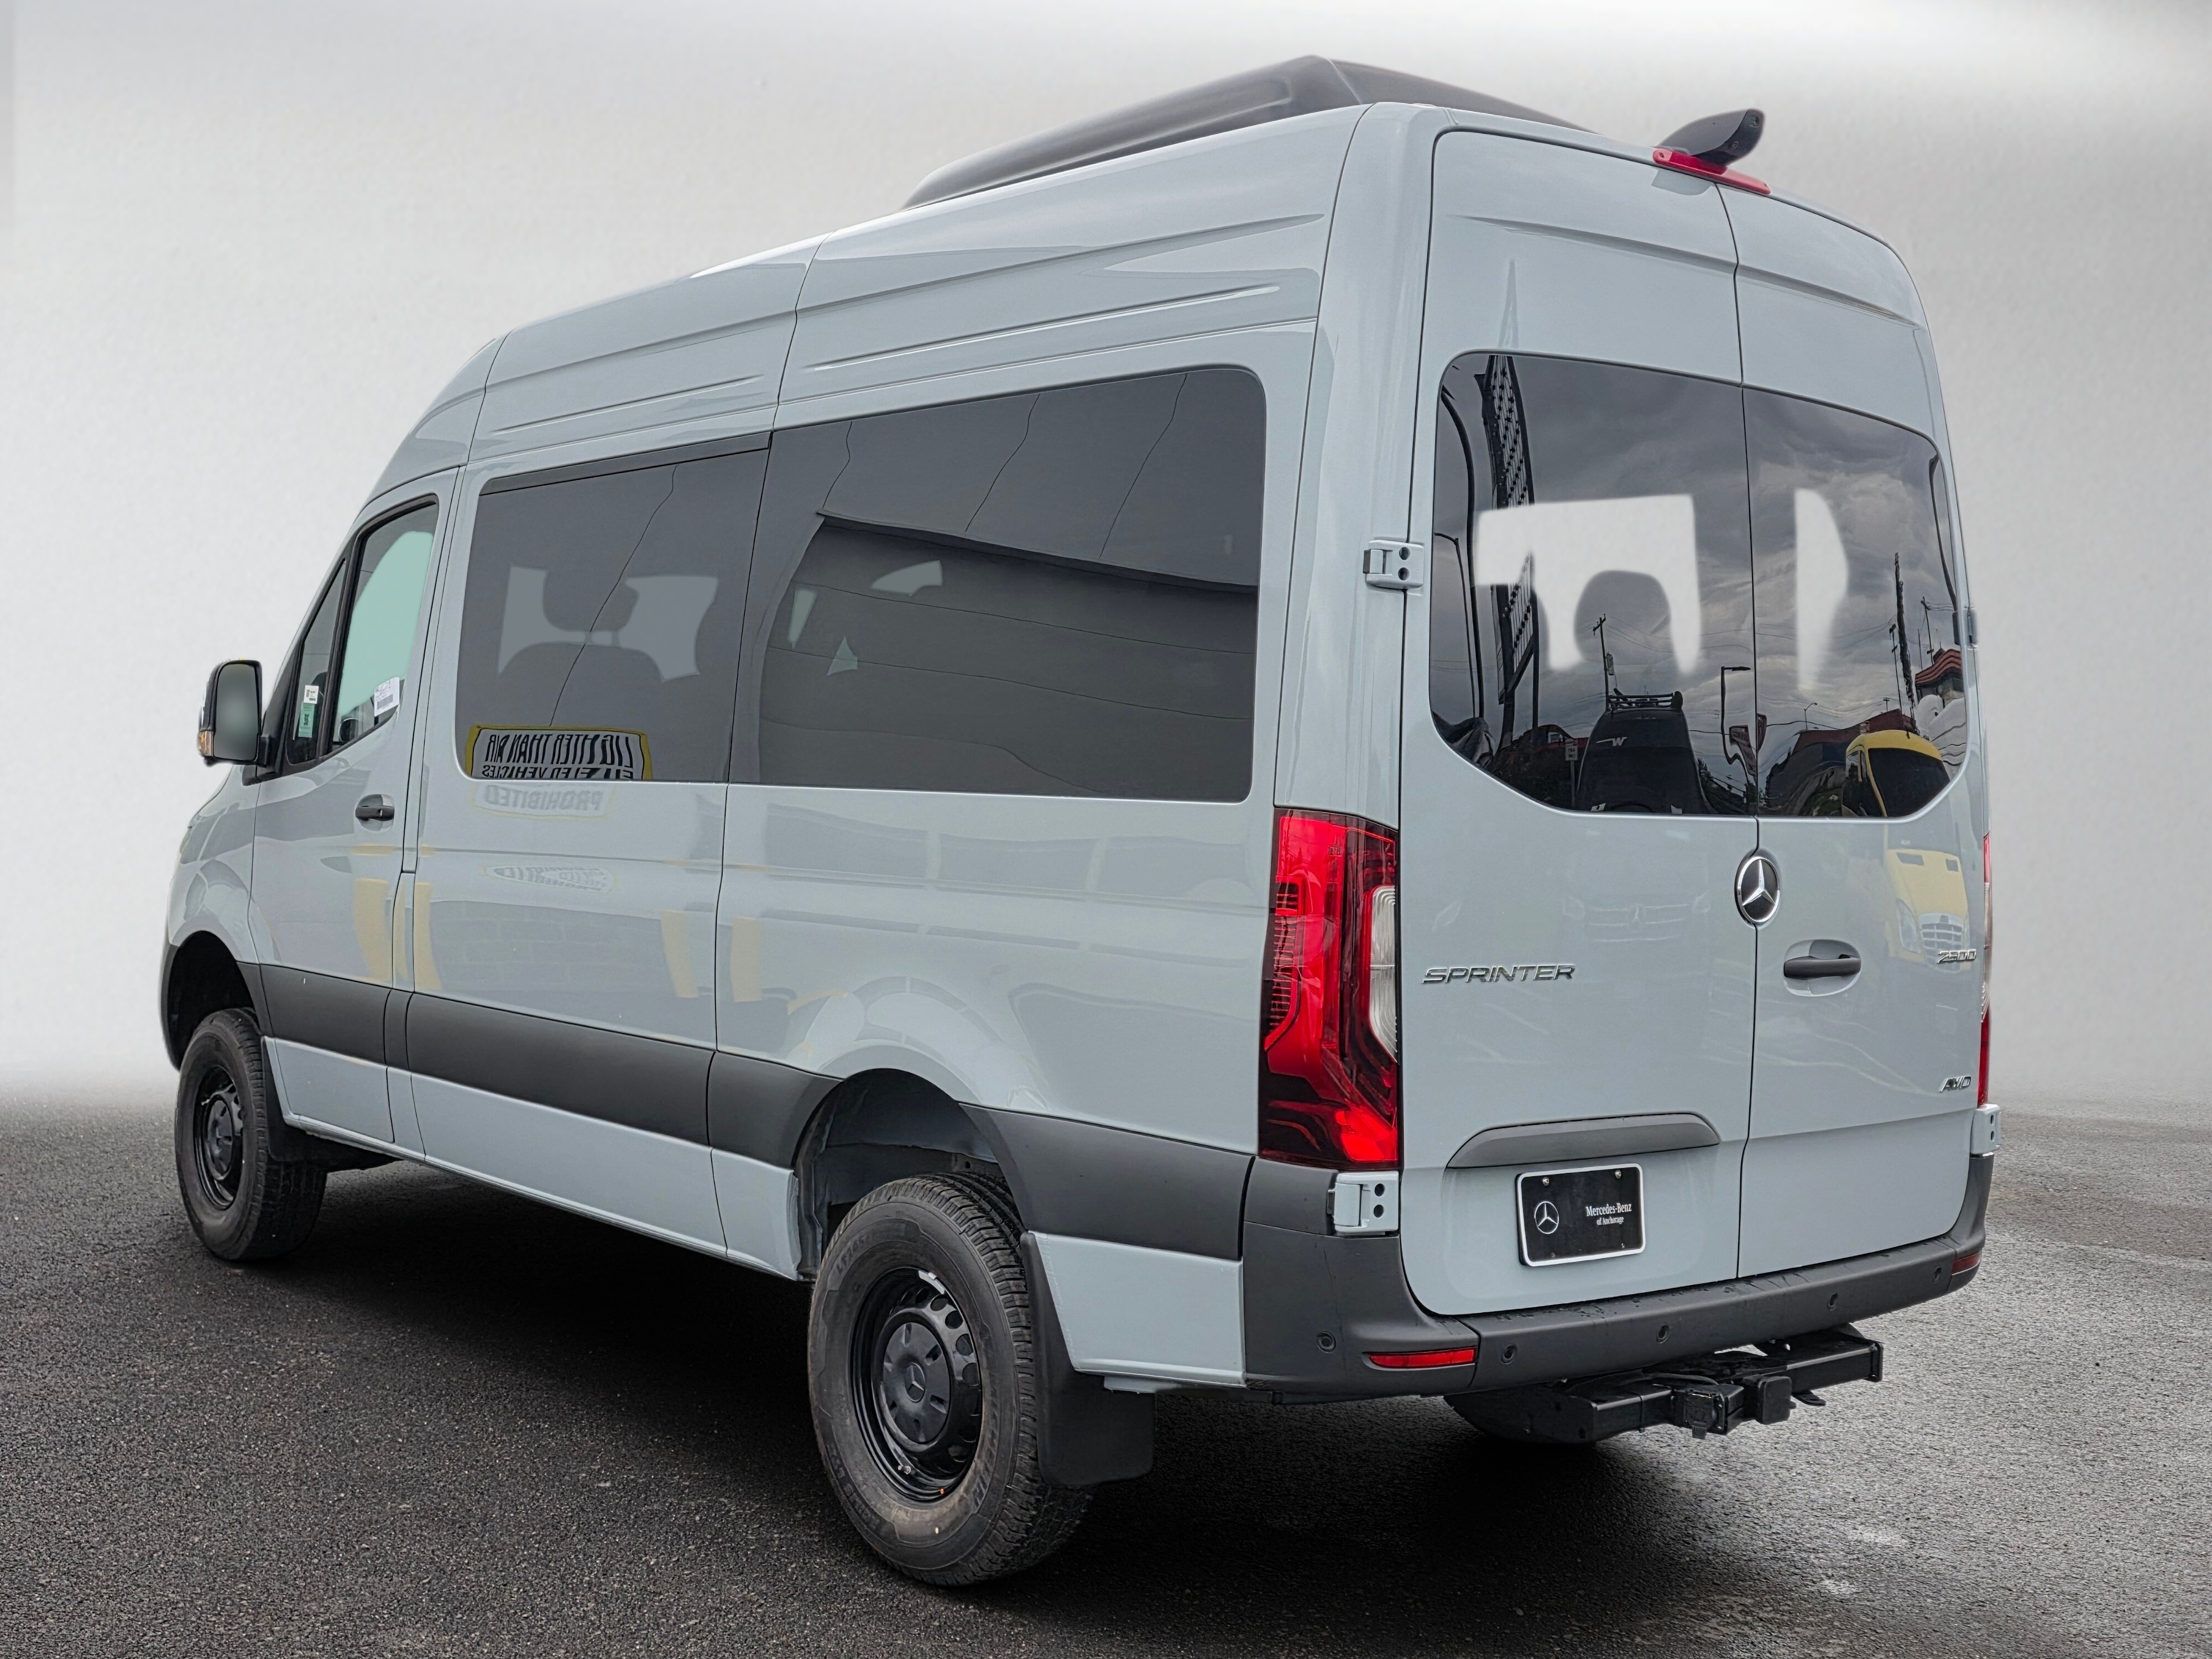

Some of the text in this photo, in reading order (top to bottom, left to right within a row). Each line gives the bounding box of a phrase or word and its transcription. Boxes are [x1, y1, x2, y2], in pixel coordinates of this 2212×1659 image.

[1937, 948, 1977, 964] 2500
[1422, 964, 1575, 984] SPRINTER
[1939, 1075, 1971, 1092] AWD
[1585, 1202, 1632, 1217] Mercedes-Benz
[1597, 1216, 1624, 1225] of Anchorage
